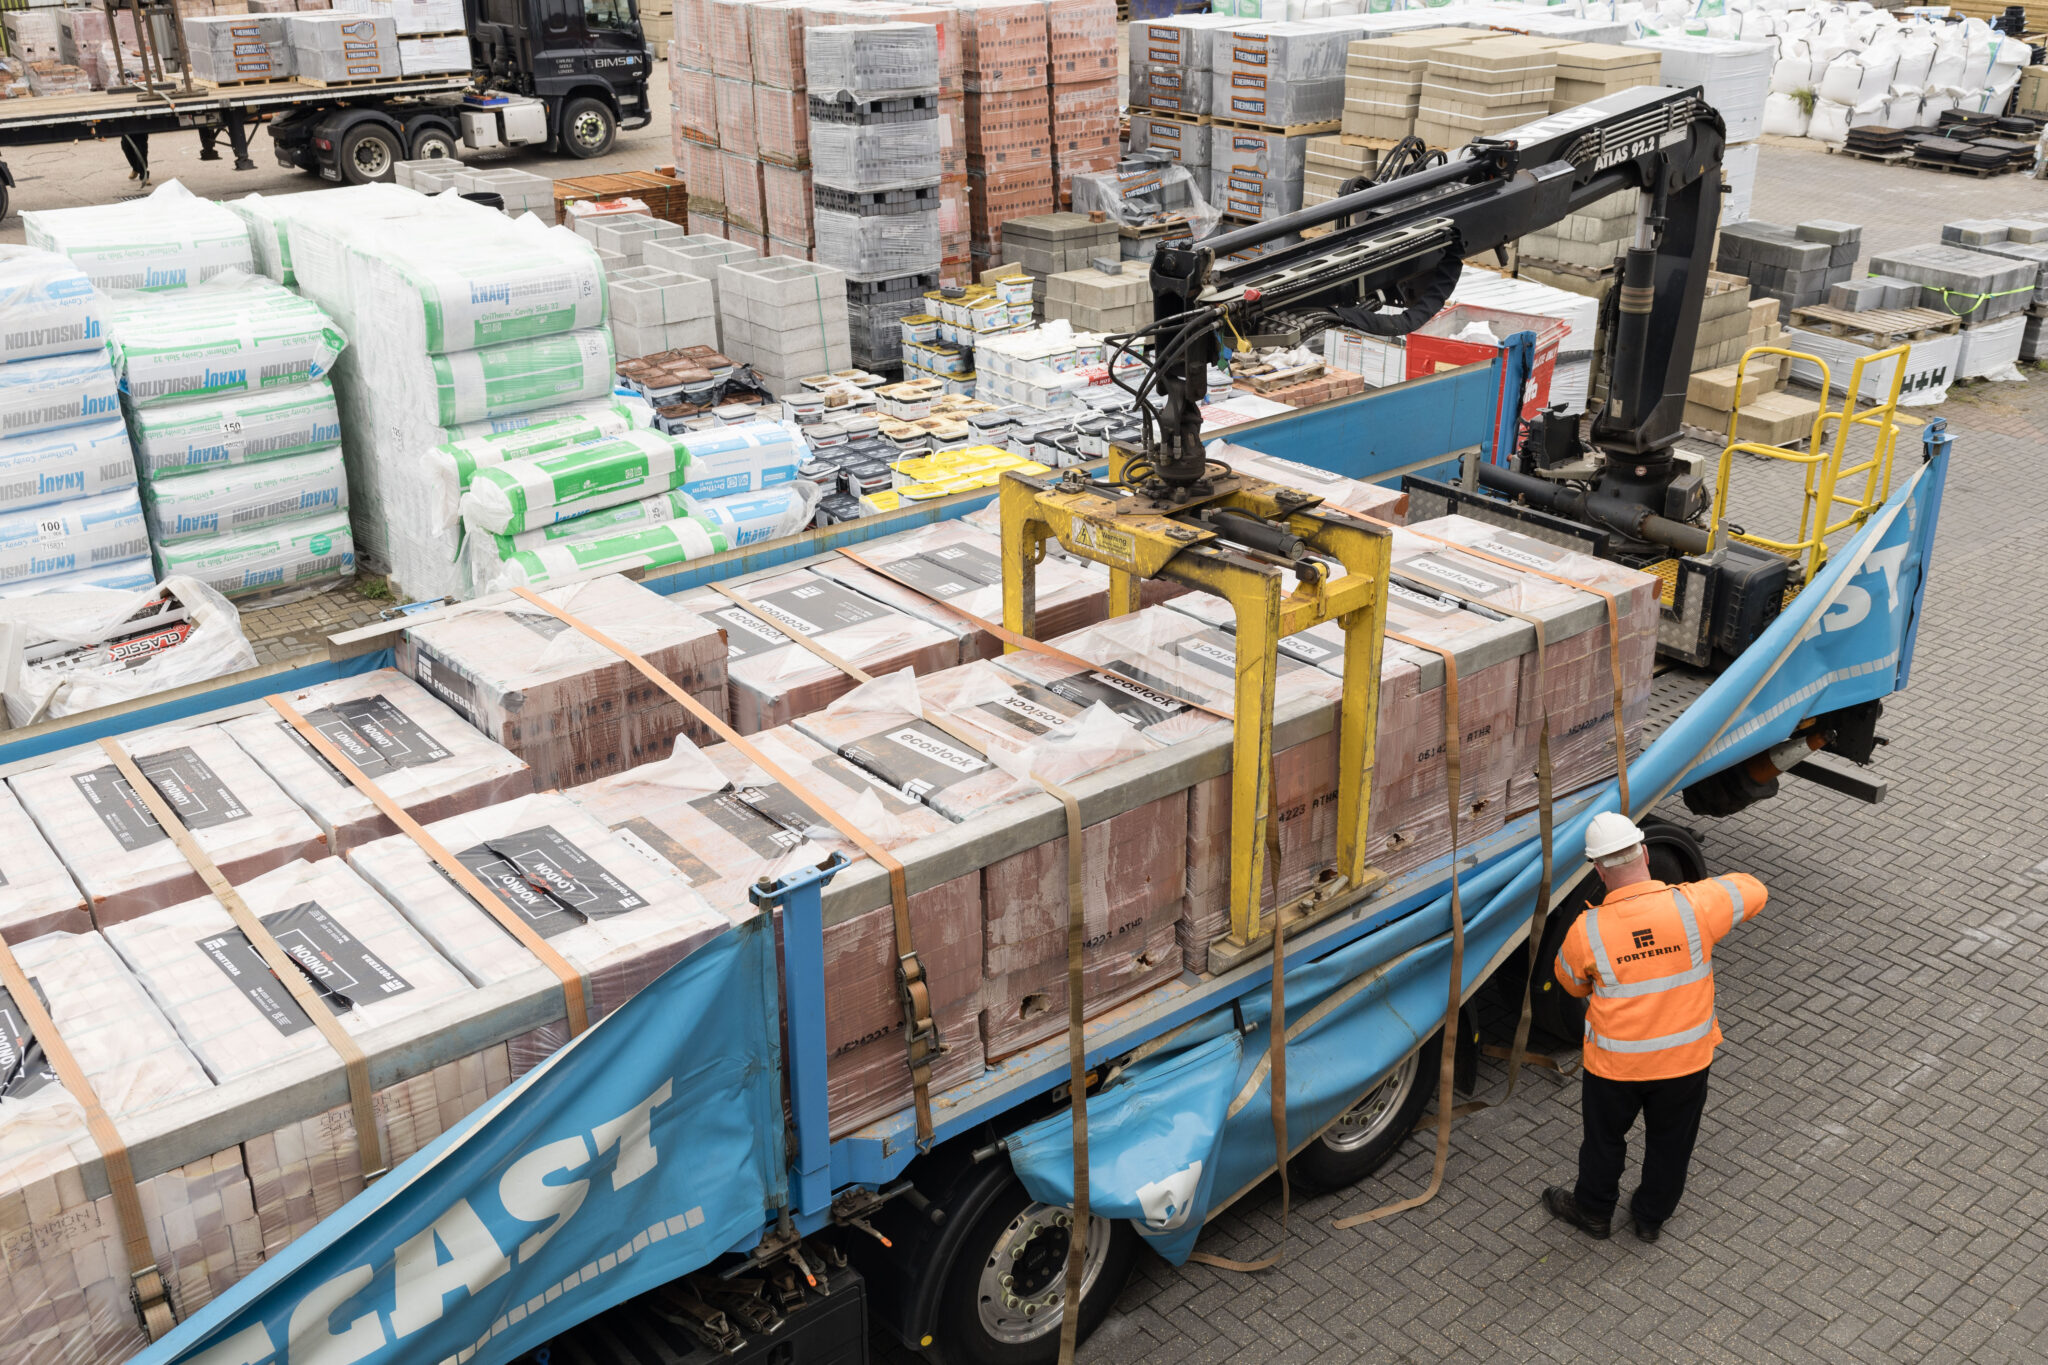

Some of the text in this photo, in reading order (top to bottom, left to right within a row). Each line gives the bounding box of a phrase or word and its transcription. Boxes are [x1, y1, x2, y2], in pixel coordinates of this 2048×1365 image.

[1151, 28, 1179, 40] THERMALITE
[1151, 52, 1179, 61] THERMALITE
[1235, 52, 1266, 64] THERMALITE
[1151, 75, 1180, 87] THERMALITE
[1234, 77, 1265, 87] THERMALITE
[1151, 97, 1179, 109] THERMALITE
[1234, 99, 1264, 113] THERMALITE
[1152, 125, 1180, 138] THERMALITE
[1235, 139, 1265, 148] THERMALITE
[1594, 146, 1628, 172] ATLAS
[1231, 179, 1261, 192] THERMALITE
[1230, 201, 1260, 214] THERMALITE
[469, 280, 510, 305] KNAUF
[583, 280, 591, 297] 125
[4, 323, 83, 350] INSULATION
[130, 374, 203, 397] INSULATION
[203, 368, 246, 389] KNAUF
[1900, 366, 1947, 395] H+H
[3, 402, 80, 429] INSULATION
[224, 422, 241, 431] 150
[243, 430, 310, 455] INSULATION
[186, 445, 229, 465] KNAUF
[38, 471, 84, 495] KNAUF
[300, 487, 338, 509] KNAUF
[41, 521, 61, 533] 100
[175, 512, 218, 535] KNAUF
[1102, 531, 1127, 547] Warning
[29, 553, 75, 575] KNAUF
[243, 567, 283, 588] KNAUF
[1418, 562, 1487, 589] ecostock
[728, 611, 785, 640] ecostock
[116, 632, 180, 658] CLASSIC
[333, 731, 366, 755] LONDON
[361, 724, 393, 748] LONDON
[1467, 725, 1491, 743] ATHR
[900, 732, 973, 767] ecostock
[160, 779, 190, 806] LONDON
[533, 862, 576, 894] LONDON
[212, 949, 242, 977] FORTERRA
[291, 944, 334, 979] LONDON
[1616, 945, 1682, 965] FORTERRA
[361, 954, 393, 981] FORTERRA
